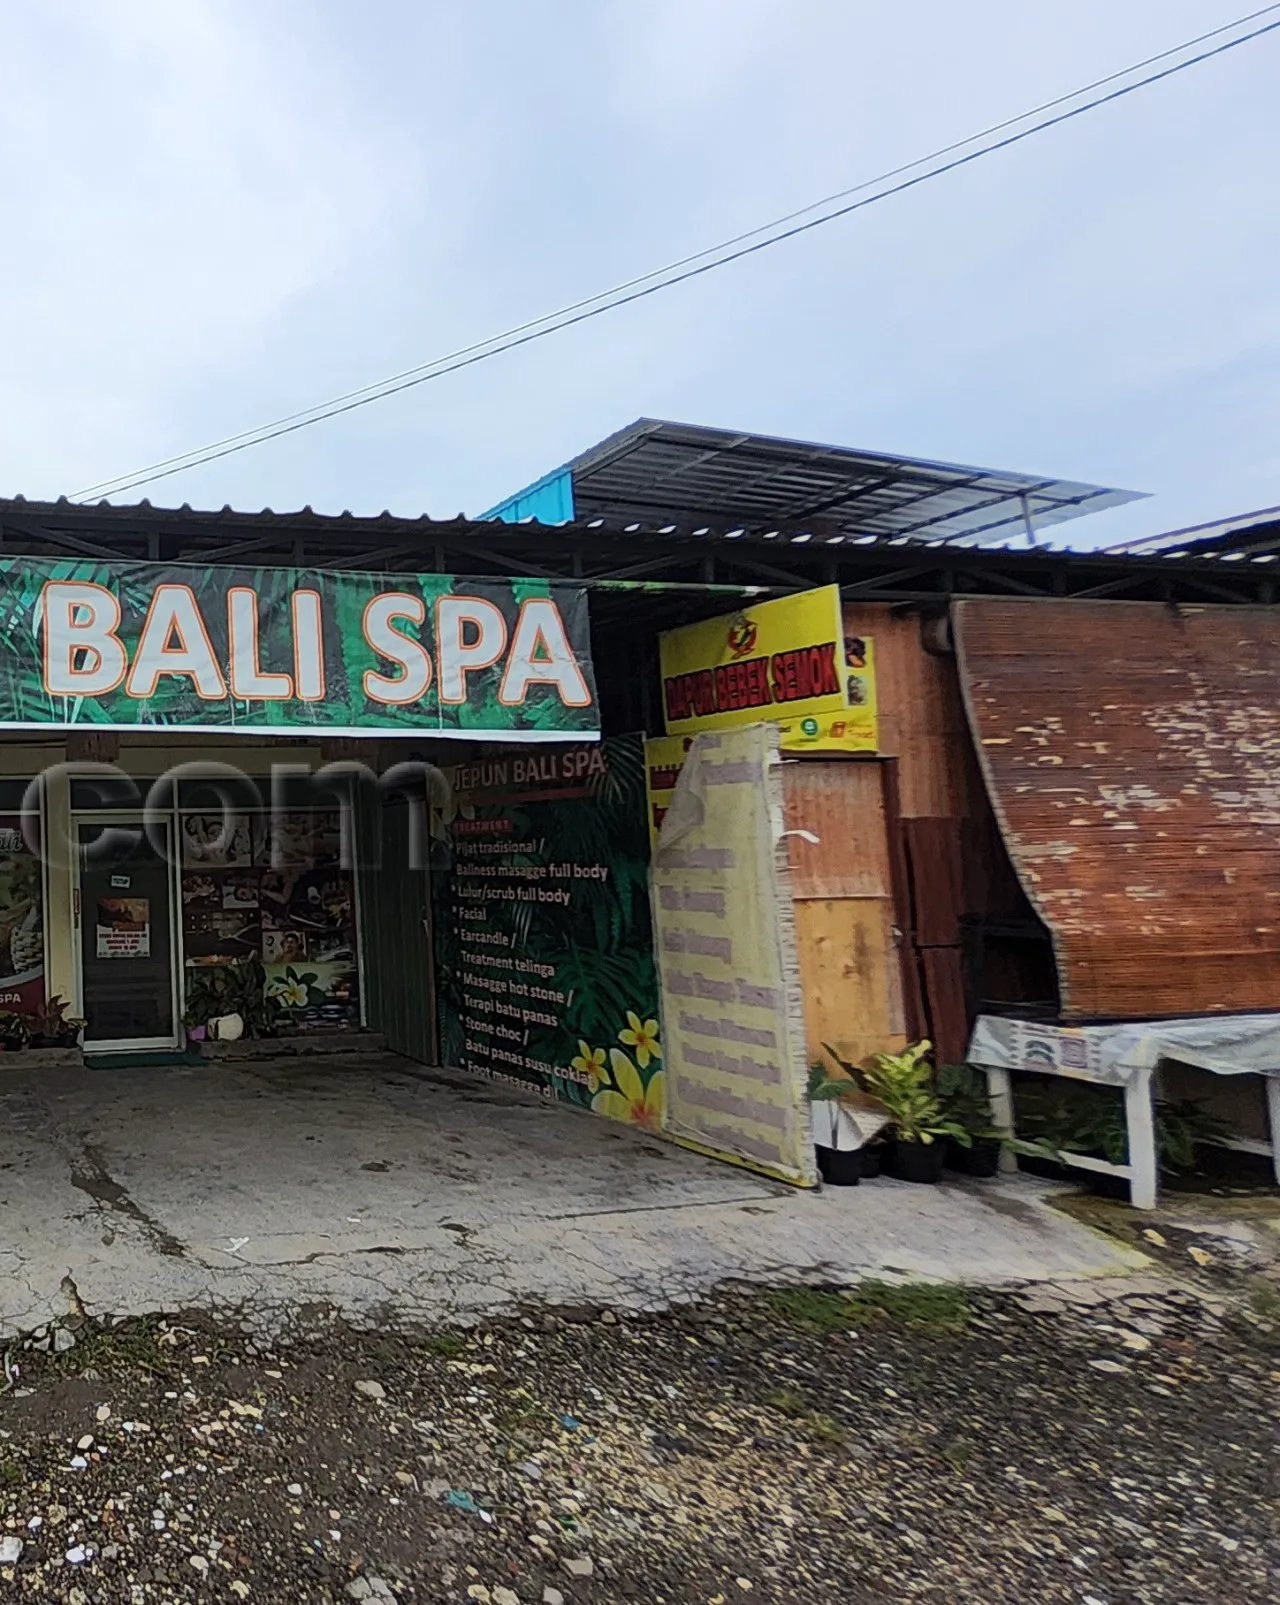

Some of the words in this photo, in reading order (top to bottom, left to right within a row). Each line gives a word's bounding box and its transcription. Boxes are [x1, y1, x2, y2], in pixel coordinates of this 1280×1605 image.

[42, 580, 325, 700] BALI
[362, 592, 592, 706] SPA
[771, 641, 841, 703] SEMOK
[454, 762, 508, 791] JEPUN
[513, 755, 557, 783] BALI
[562, 746, 607, 778] SPA
[479, 839, 537, 854] tradisional
[549, 863, 571, 878] full
[573, 863, 609, 881] body
[516, 886, 536, 901] full
[538, 888, 571, 907] body
[459, 906, 487, 921] Facial
[460, 928, 509, 946] Earcandle
[460, 950, 513, 970] Treatment
[514, 958, 555, 979] telinga
[463, 972, 507, 994] Masagge
[508, 979, 529, 997] hot
[530, 988, 565, 1005] stone
[463, 994, 494, 1014] Terapi
[495, 1001, 521, 1018] batu
[522, 1009, 558, 1027] panas
[465, 1016, 494, 1035] Stone
[495, 1023, 522, 1042] choc
[465, 1038, 490, 1056] Batu
[491, 1047, 524, 1066] panas
[525, 1057, 552, 1075] susu
[553, 1065, 594, 1086] coklat
[468, 1060, 491, 1078] Foot
